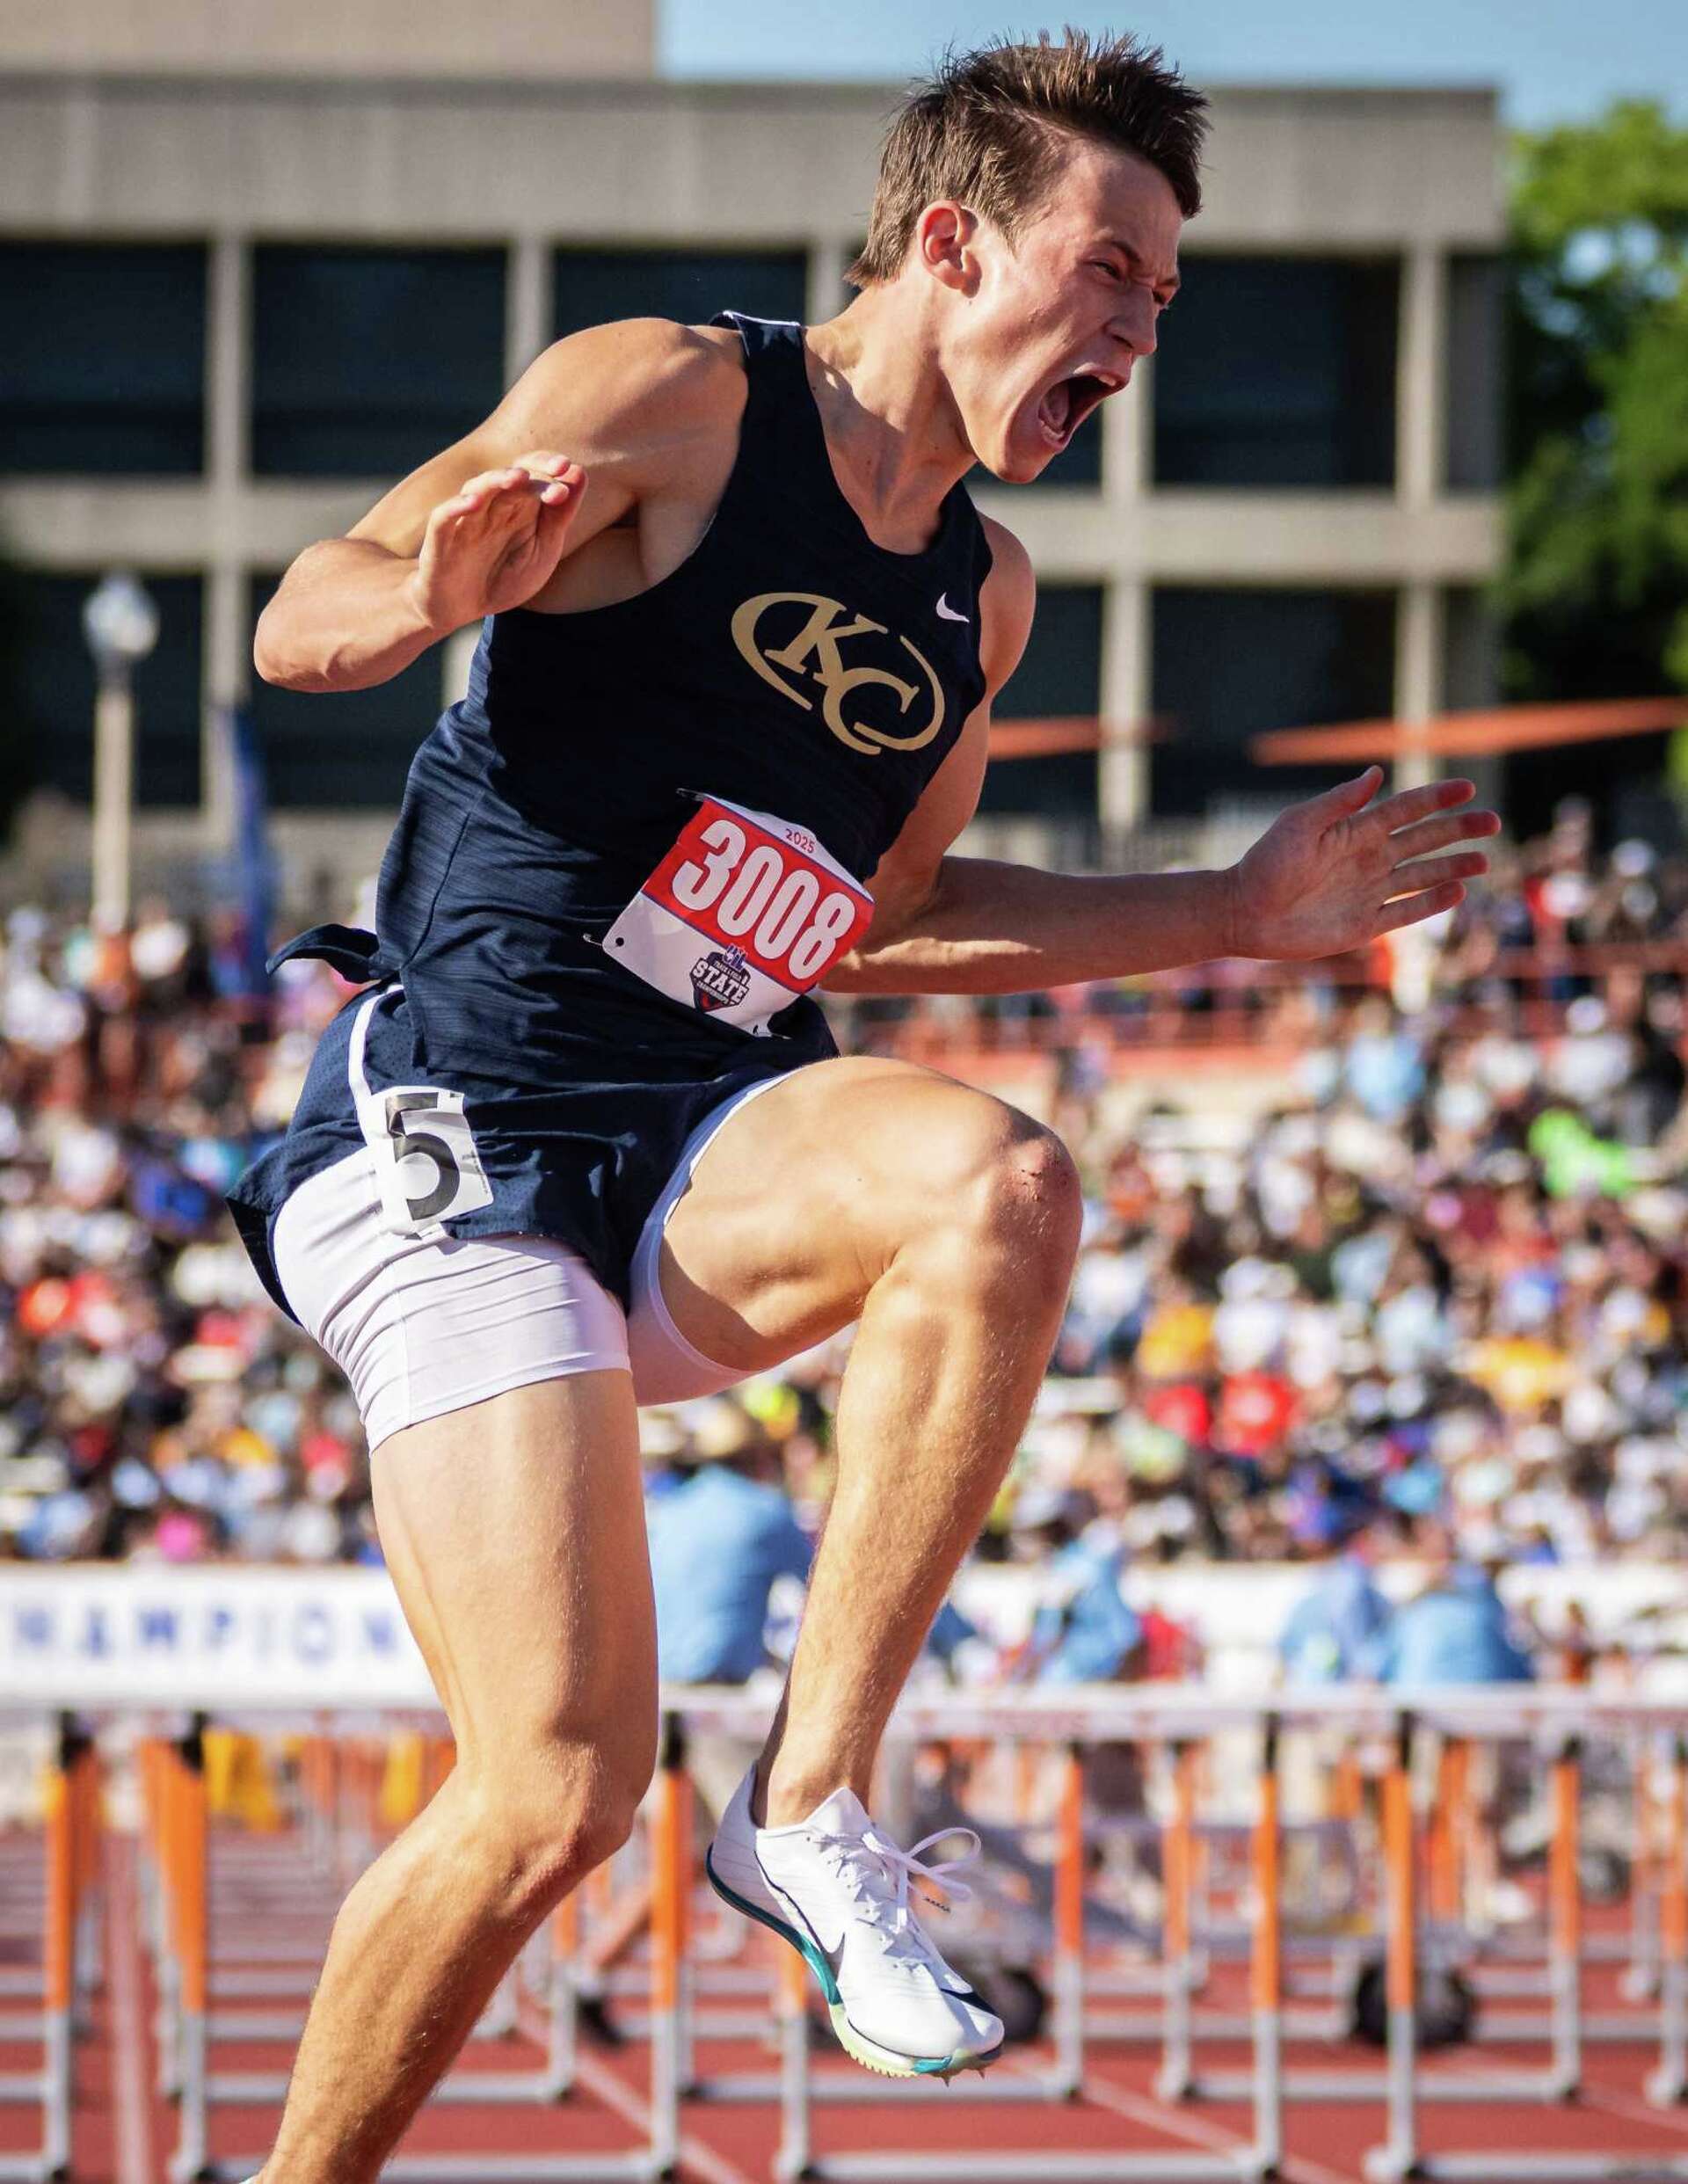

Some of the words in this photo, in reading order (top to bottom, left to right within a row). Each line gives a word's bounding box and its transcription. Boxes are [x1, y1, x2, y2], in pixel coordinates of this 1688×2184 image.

[763, 603, 920, 755] KC
[672, 819, 855, 979] 3008
[786, 828, 814, 853] 2025
[692, 960, 749, 1002] STATE
[385, 1092, 461, 1221] 5
